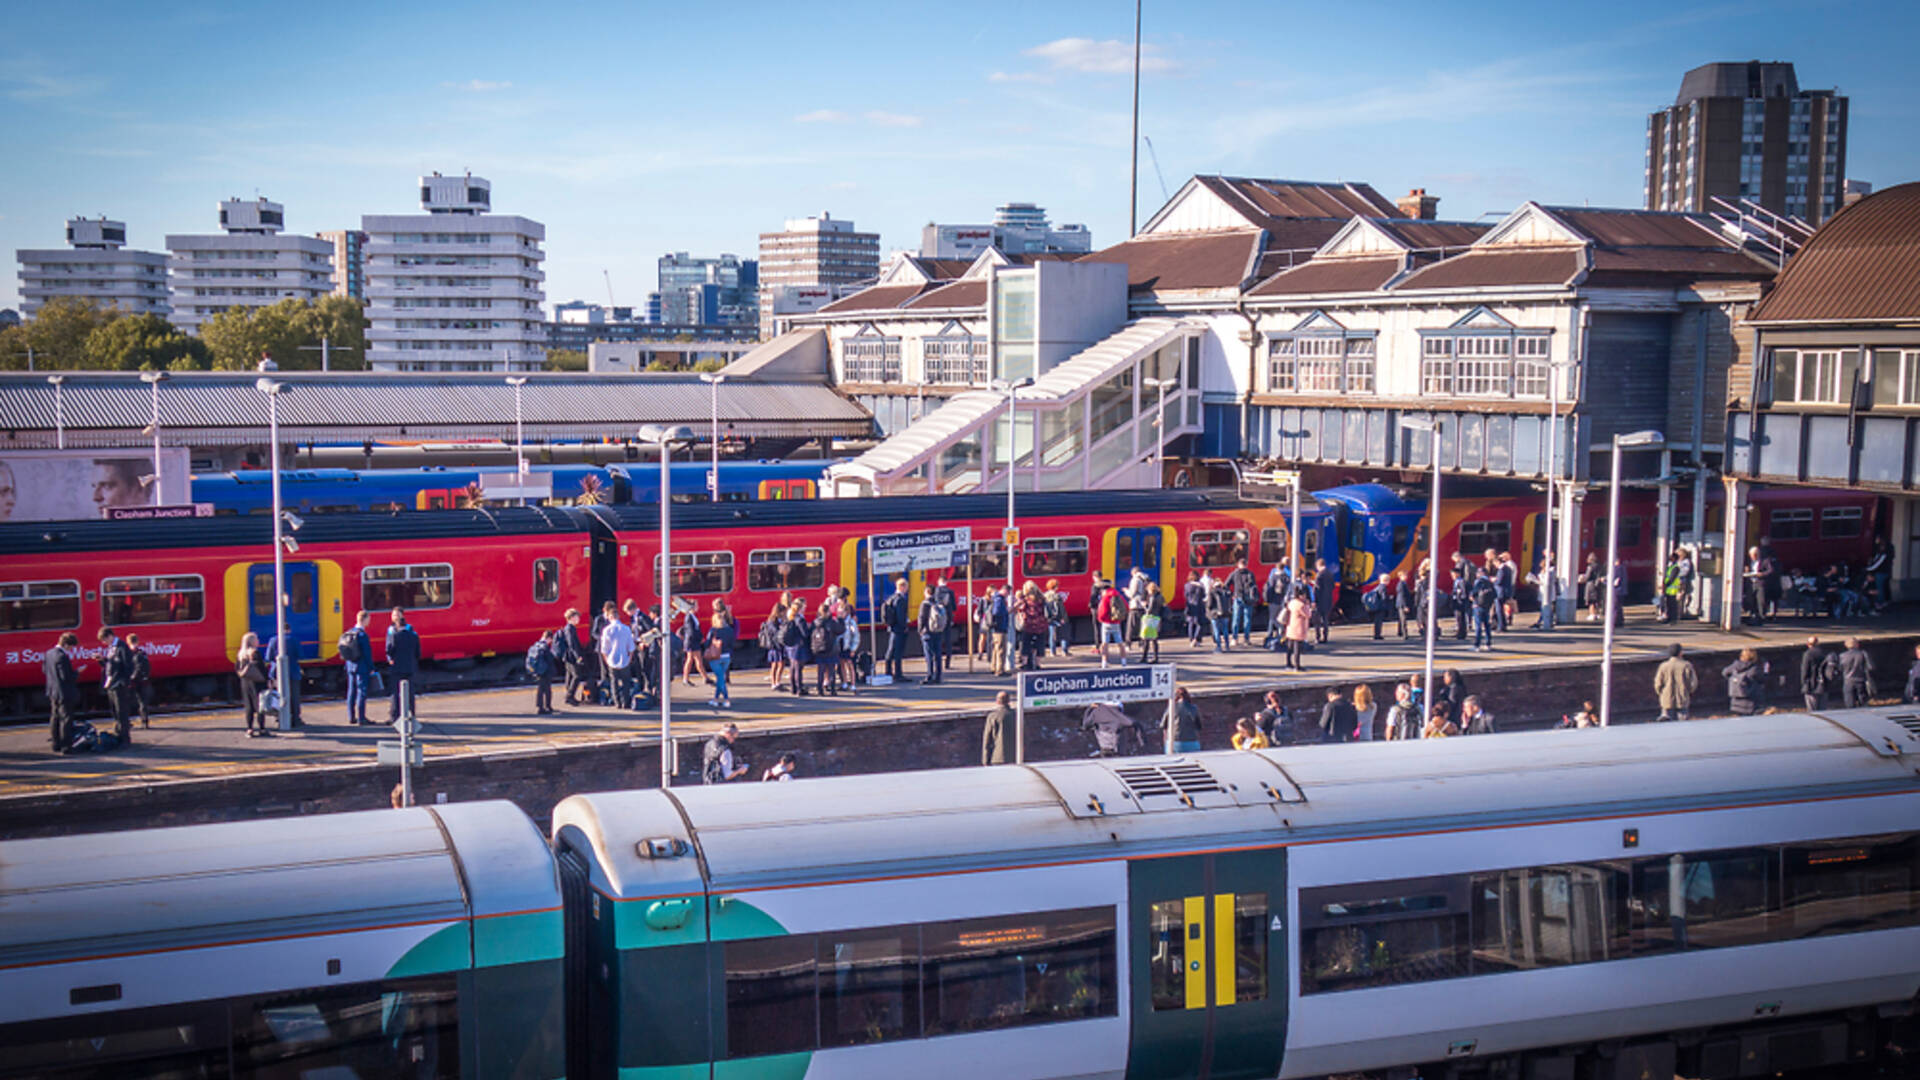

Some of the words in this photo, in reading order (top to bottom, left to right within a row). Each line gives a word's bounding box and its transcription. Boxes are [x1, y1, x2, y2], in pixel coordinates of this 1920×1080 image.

[154, 508, 191, 518] Junction
[878, 536, 914, 549] Clapham
[915, 534, 951, 545] Junction
[1034, 676, 1088, 693] Clapham
[1091, 673, 1143, 689] Junction
[1155, 672, 1168, 685] 14
